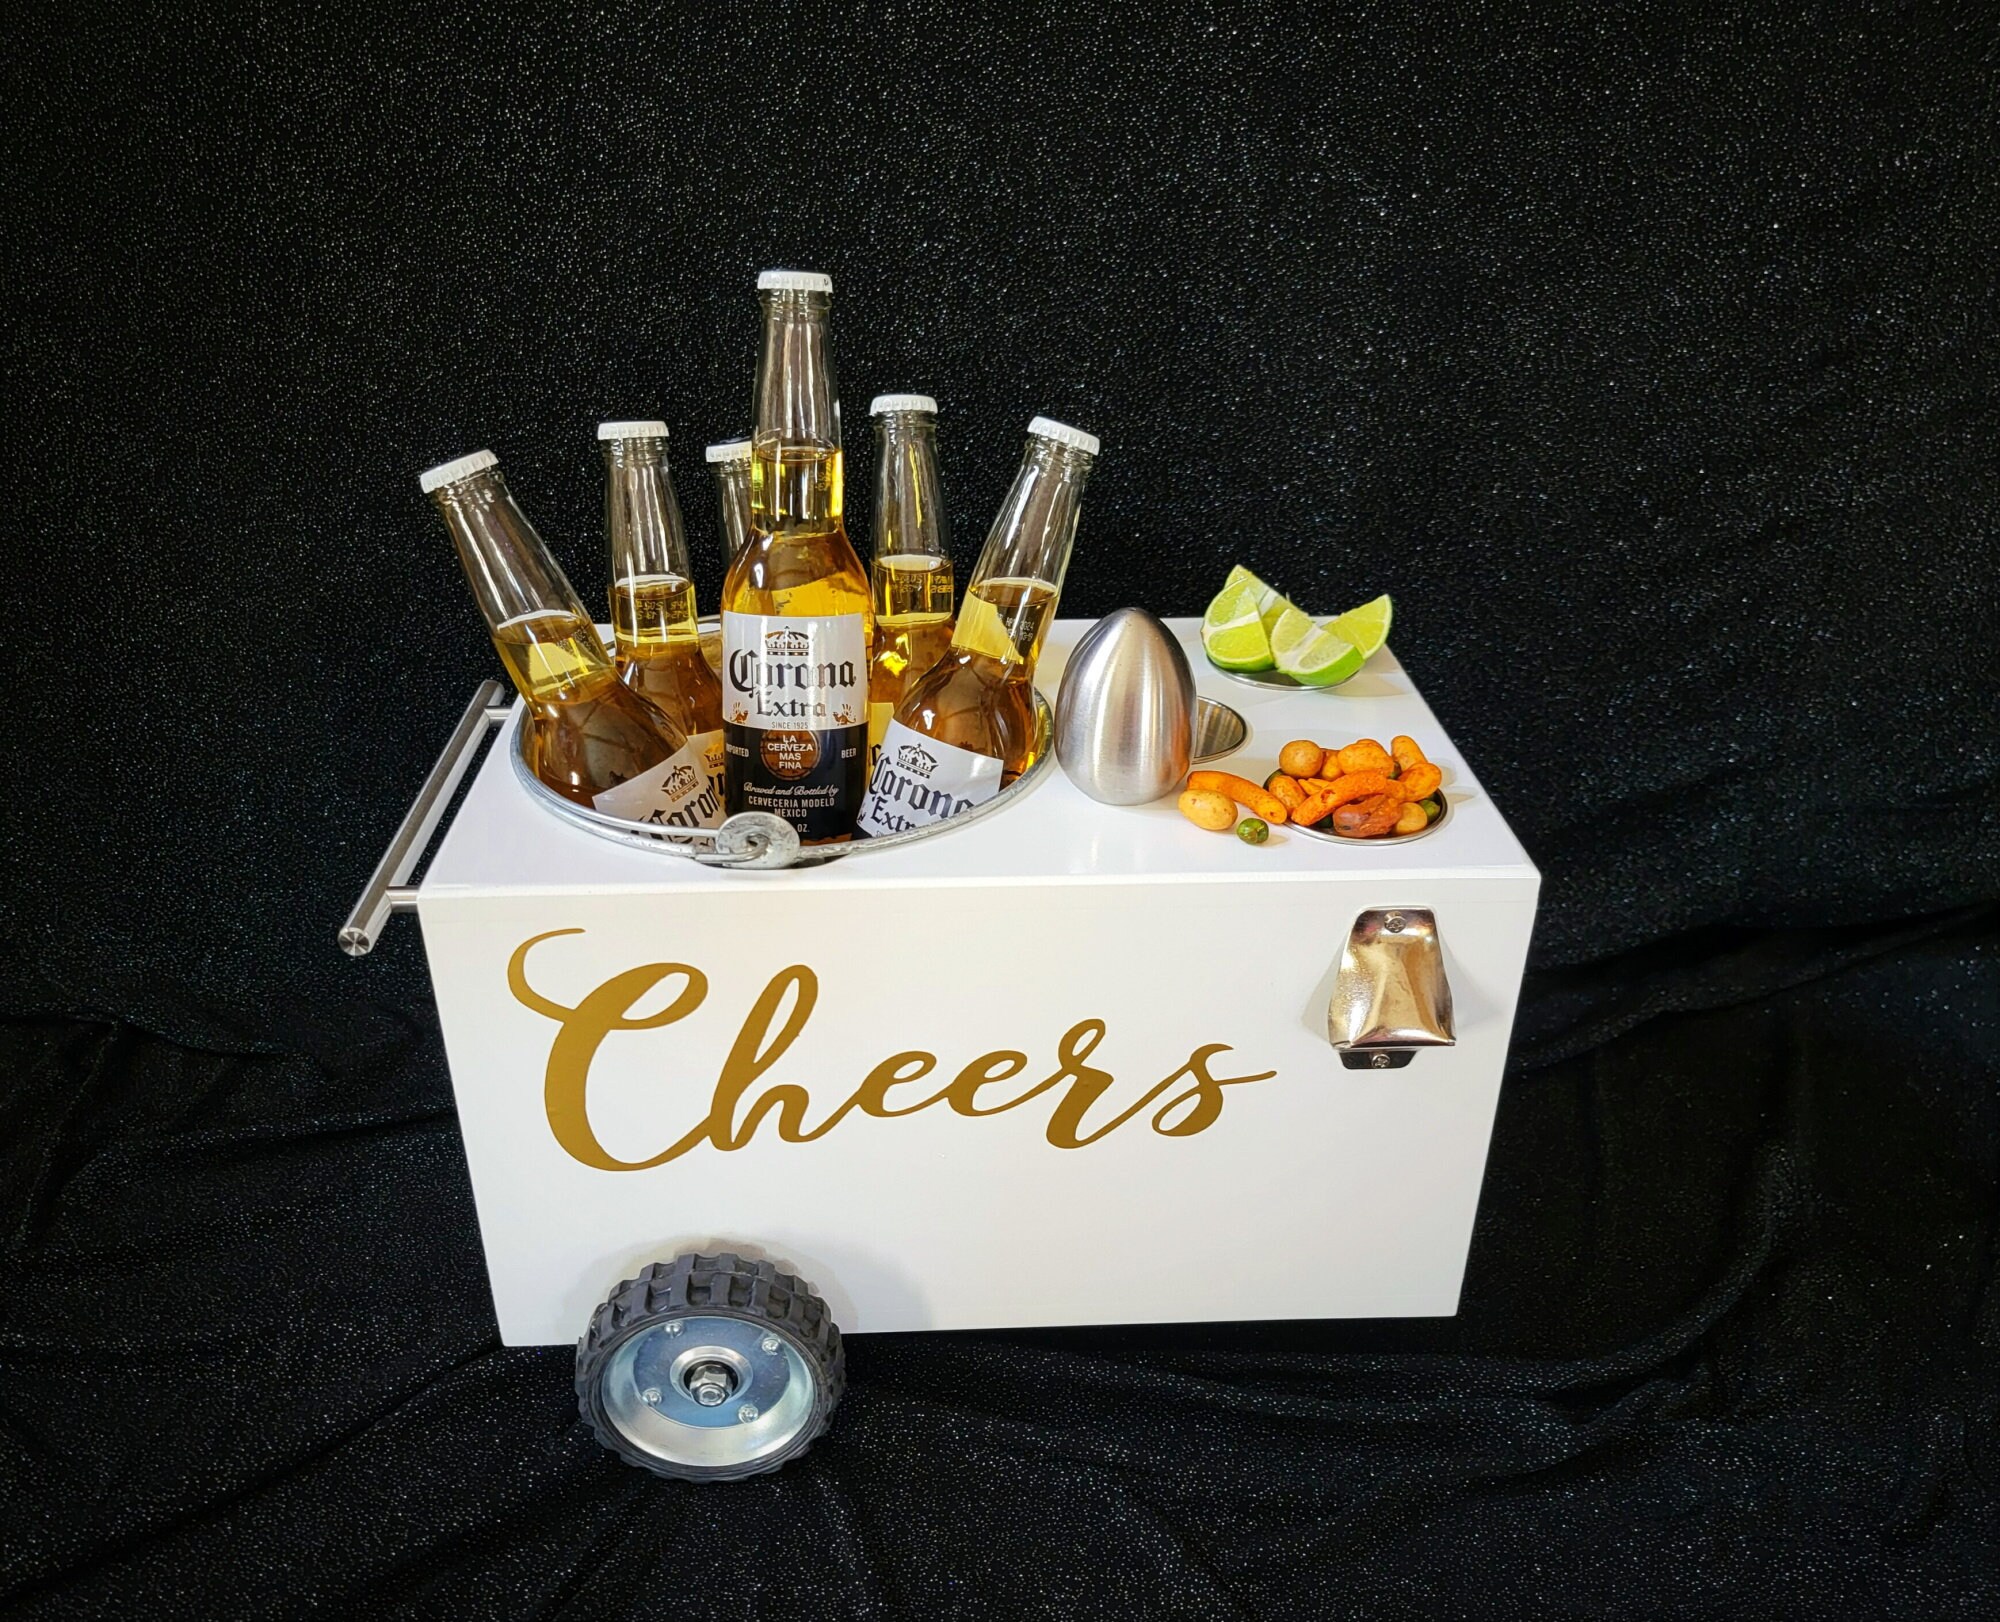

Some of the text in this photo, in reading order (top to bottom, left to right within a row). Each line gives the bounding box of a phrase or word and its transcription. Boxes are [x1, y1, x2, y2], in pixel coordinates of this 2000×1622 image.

[729, 648, 856, 698] Corona
[756, 691, 827, 717] Extra
[771, 721, 809, 730] SINCE 1925
[782, 734, 797, 743] LA
[767, 743, 813, 752] CERVEZA
[779, 752, 802, 761] MAS
[841, 747, 857, 759] BEER
[778, 761, 802, 770] FINA
[748, 795, 835, 808] CERVECERIA MODELO
[774, 808, 807, 818] MEXICO
[507, 928, 1275, 1171] Cheers
